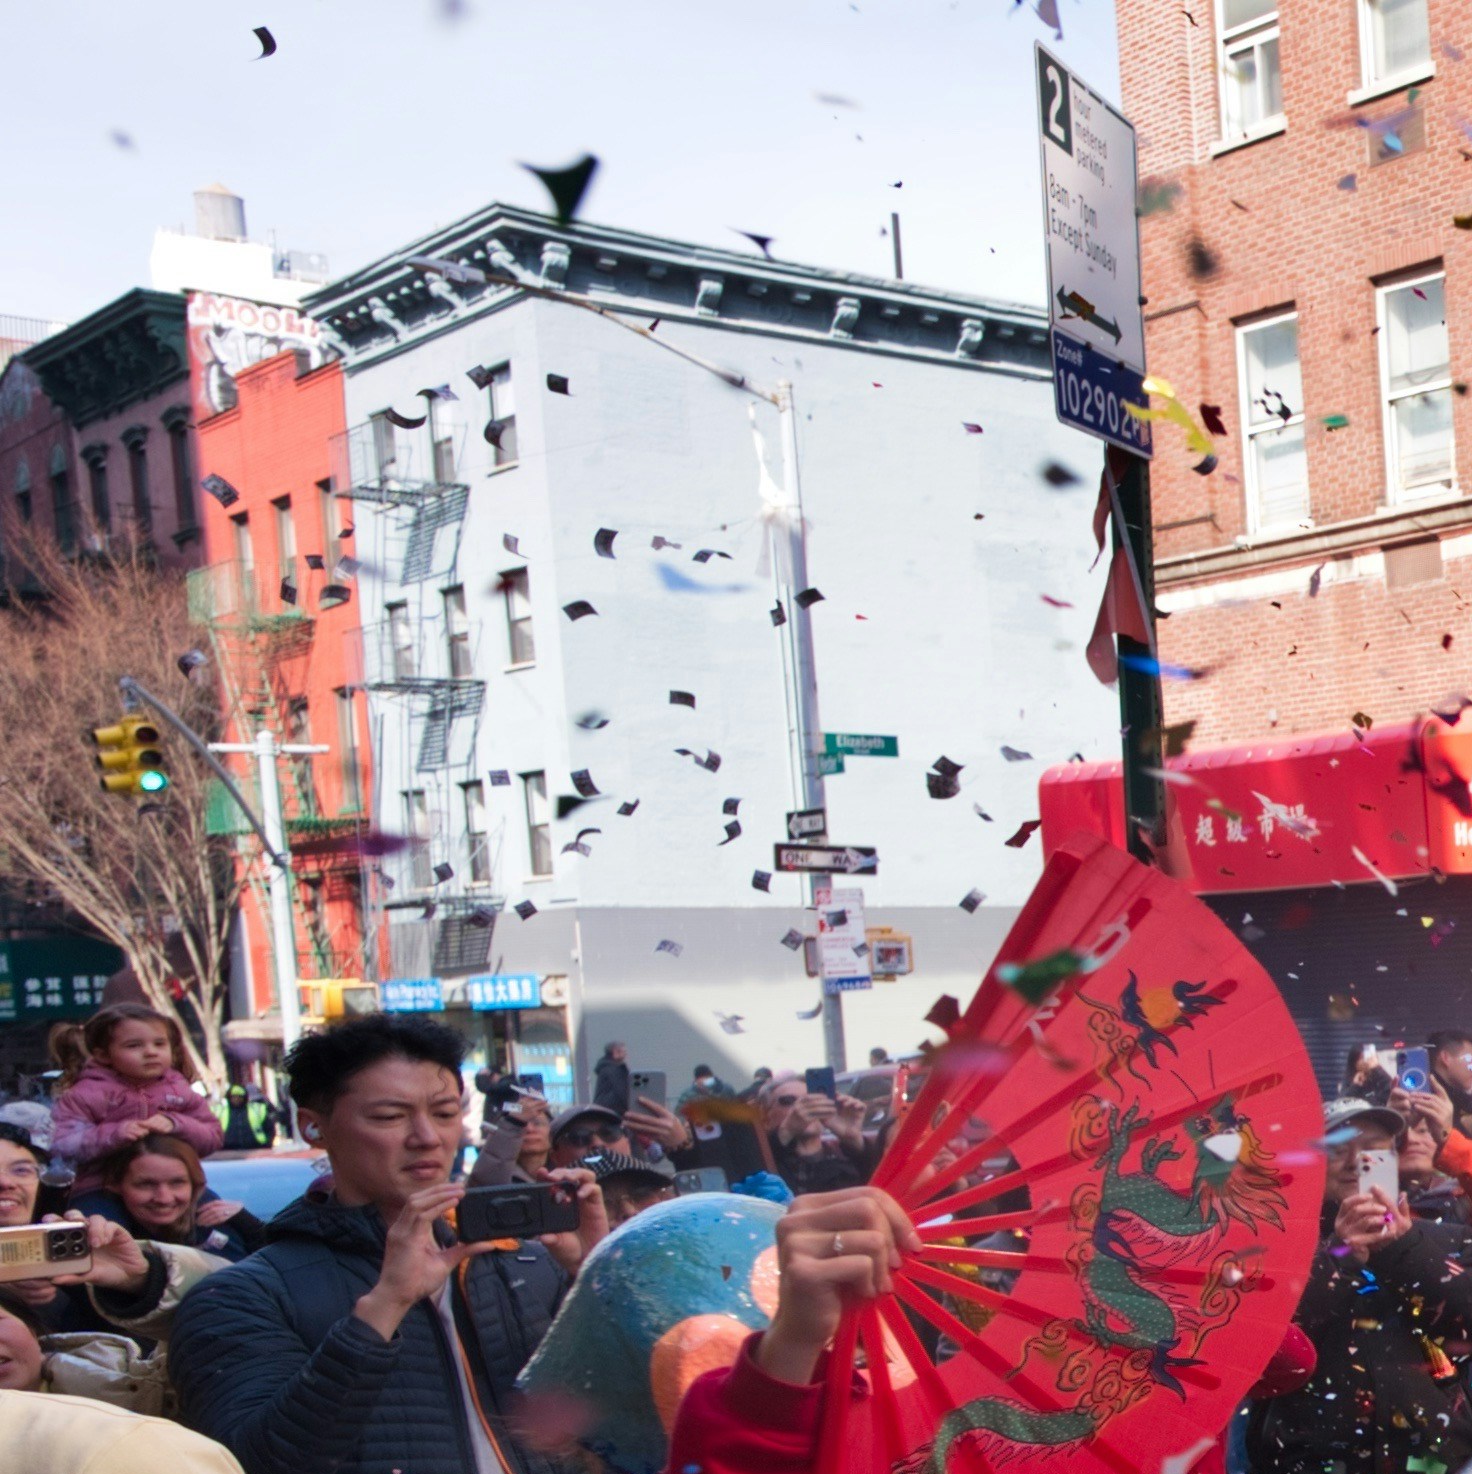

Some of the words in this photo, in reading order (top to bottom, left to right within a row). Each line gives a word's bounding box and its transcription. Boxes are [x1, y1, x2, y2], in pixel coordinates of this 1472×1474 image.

[1046, 65, 1065, 142] 2
[1074, 89, 1091, 121] hour
[1075, 121, 1108, 160] metered
[1077, 147, 1105, 187] parking
[1050, 173, 1069, 209] 8am
[1079, 194, 1098, 230] 7pm
[1051, 208, 1084, 254] Except
[1085, 232, 1118, 281] Sunday
[1056, 339, 1082, 368] Zone#
[836, 734, 885, 749] Elizabeth
